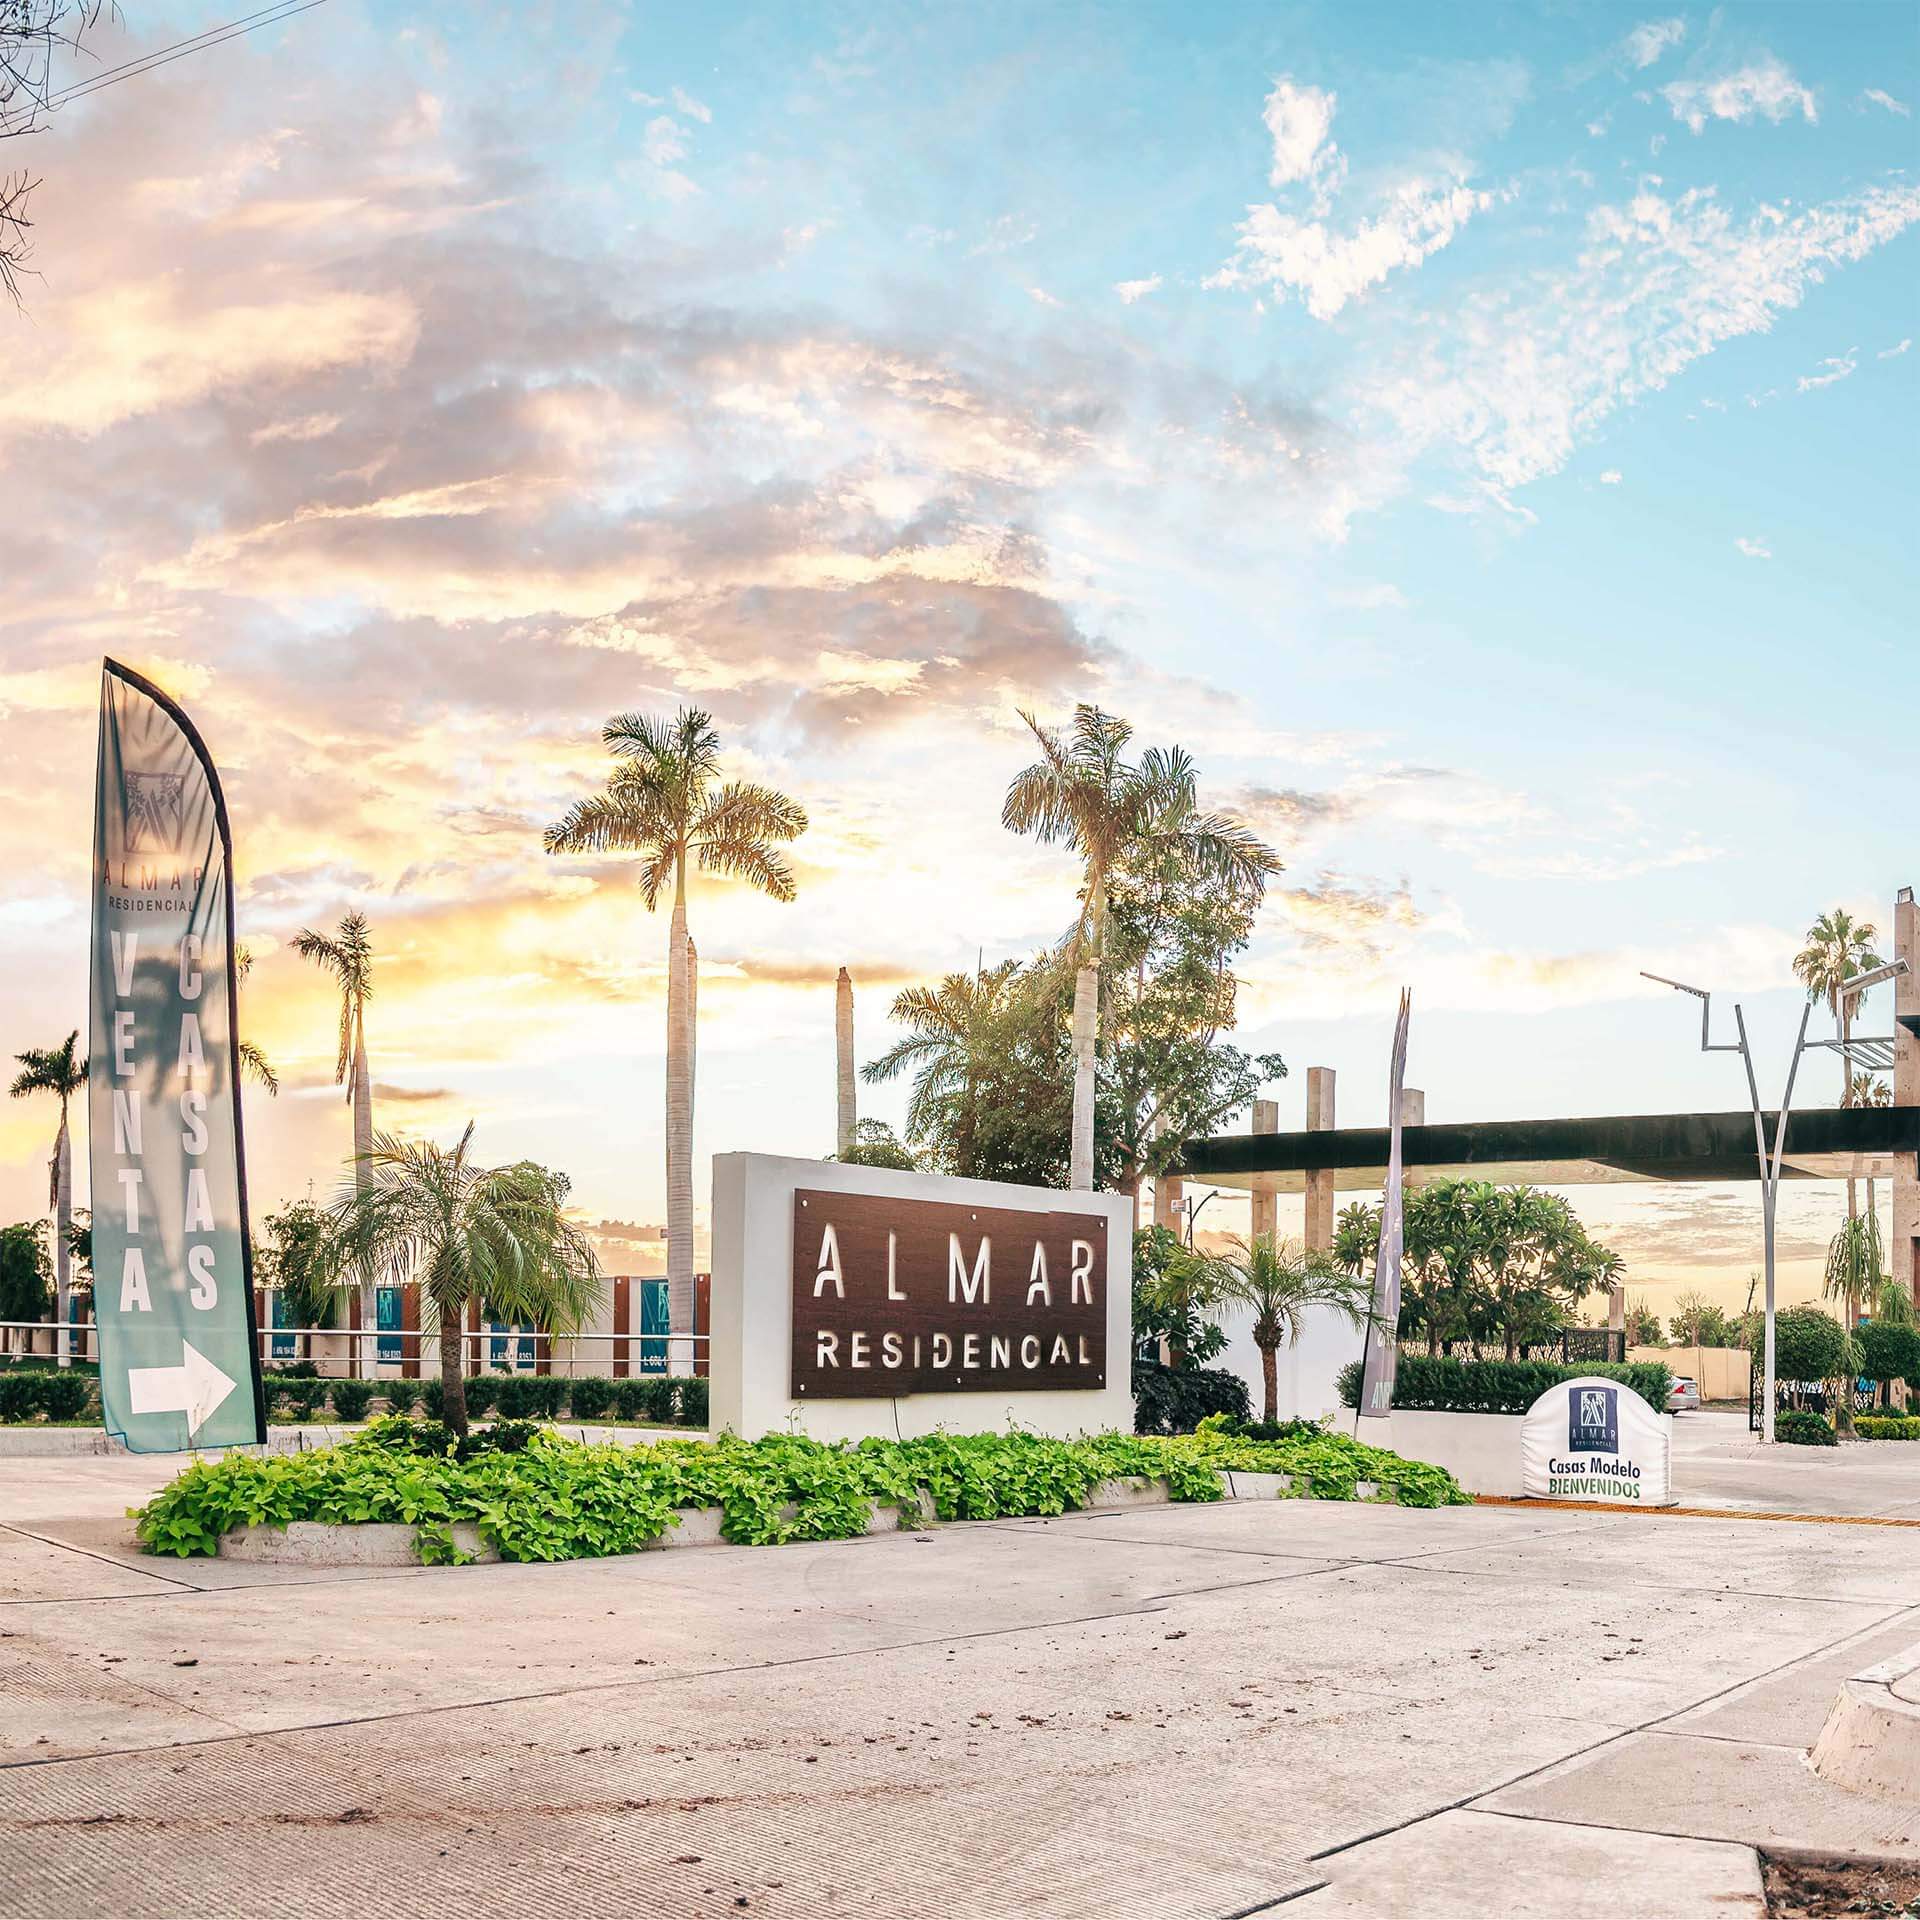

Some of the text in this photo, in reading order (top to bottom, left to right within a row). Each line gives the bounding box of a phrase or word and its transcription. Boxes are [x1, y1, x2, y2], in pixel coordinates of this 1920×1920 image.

[103, 859, 203, 892] ALMAR
[109, 896, 194, 912] RESIDENCIAL
[110, 931, 152, 1312] VENTA
[177, 933, 217, 1311] CASAS
[813, 1222, 1094, 1306] ALMAR
[1572, 1427, 1616, 1440] ALMAR
[1549, 1457, 1640, 1478] Casas Modelo
[1549, 1478, 1640, 1499] BIENVENIDOS
